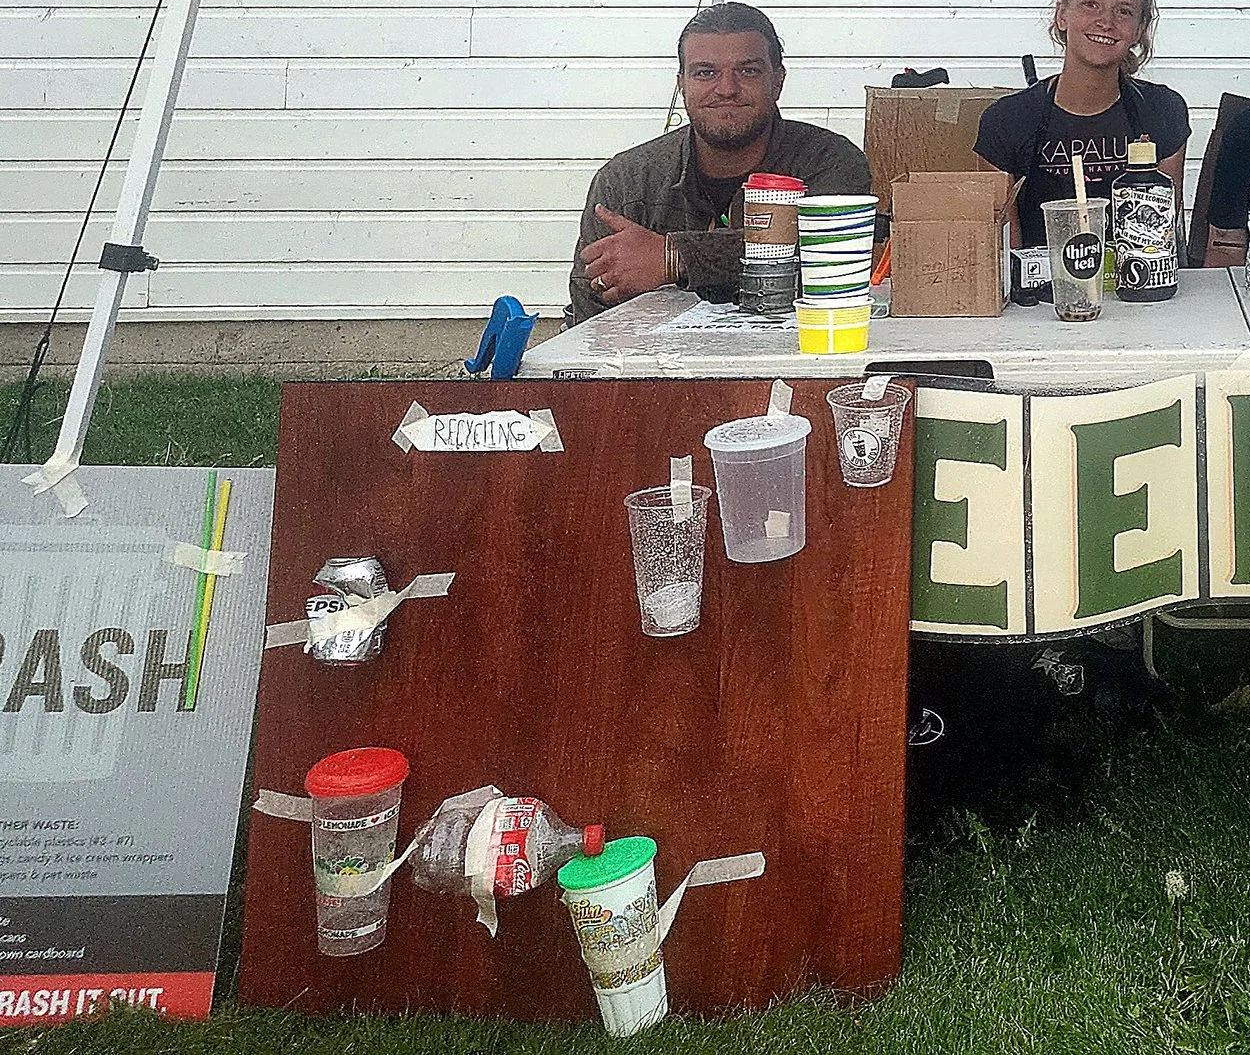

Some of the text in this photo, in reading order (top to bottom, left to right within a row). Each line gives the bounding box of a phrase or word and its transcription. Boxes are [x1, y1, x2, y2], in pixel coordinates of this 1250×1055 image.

[1074, 256, 1096, 271] tea
[0, 628, 203, 714] ASH
[33, 820, 80, 830] WASTE:
[322, 819, 368, 830] LEMONADE
[123, 854, 174, 865] wrappers
[25, 946, 86, 960] cardboard
